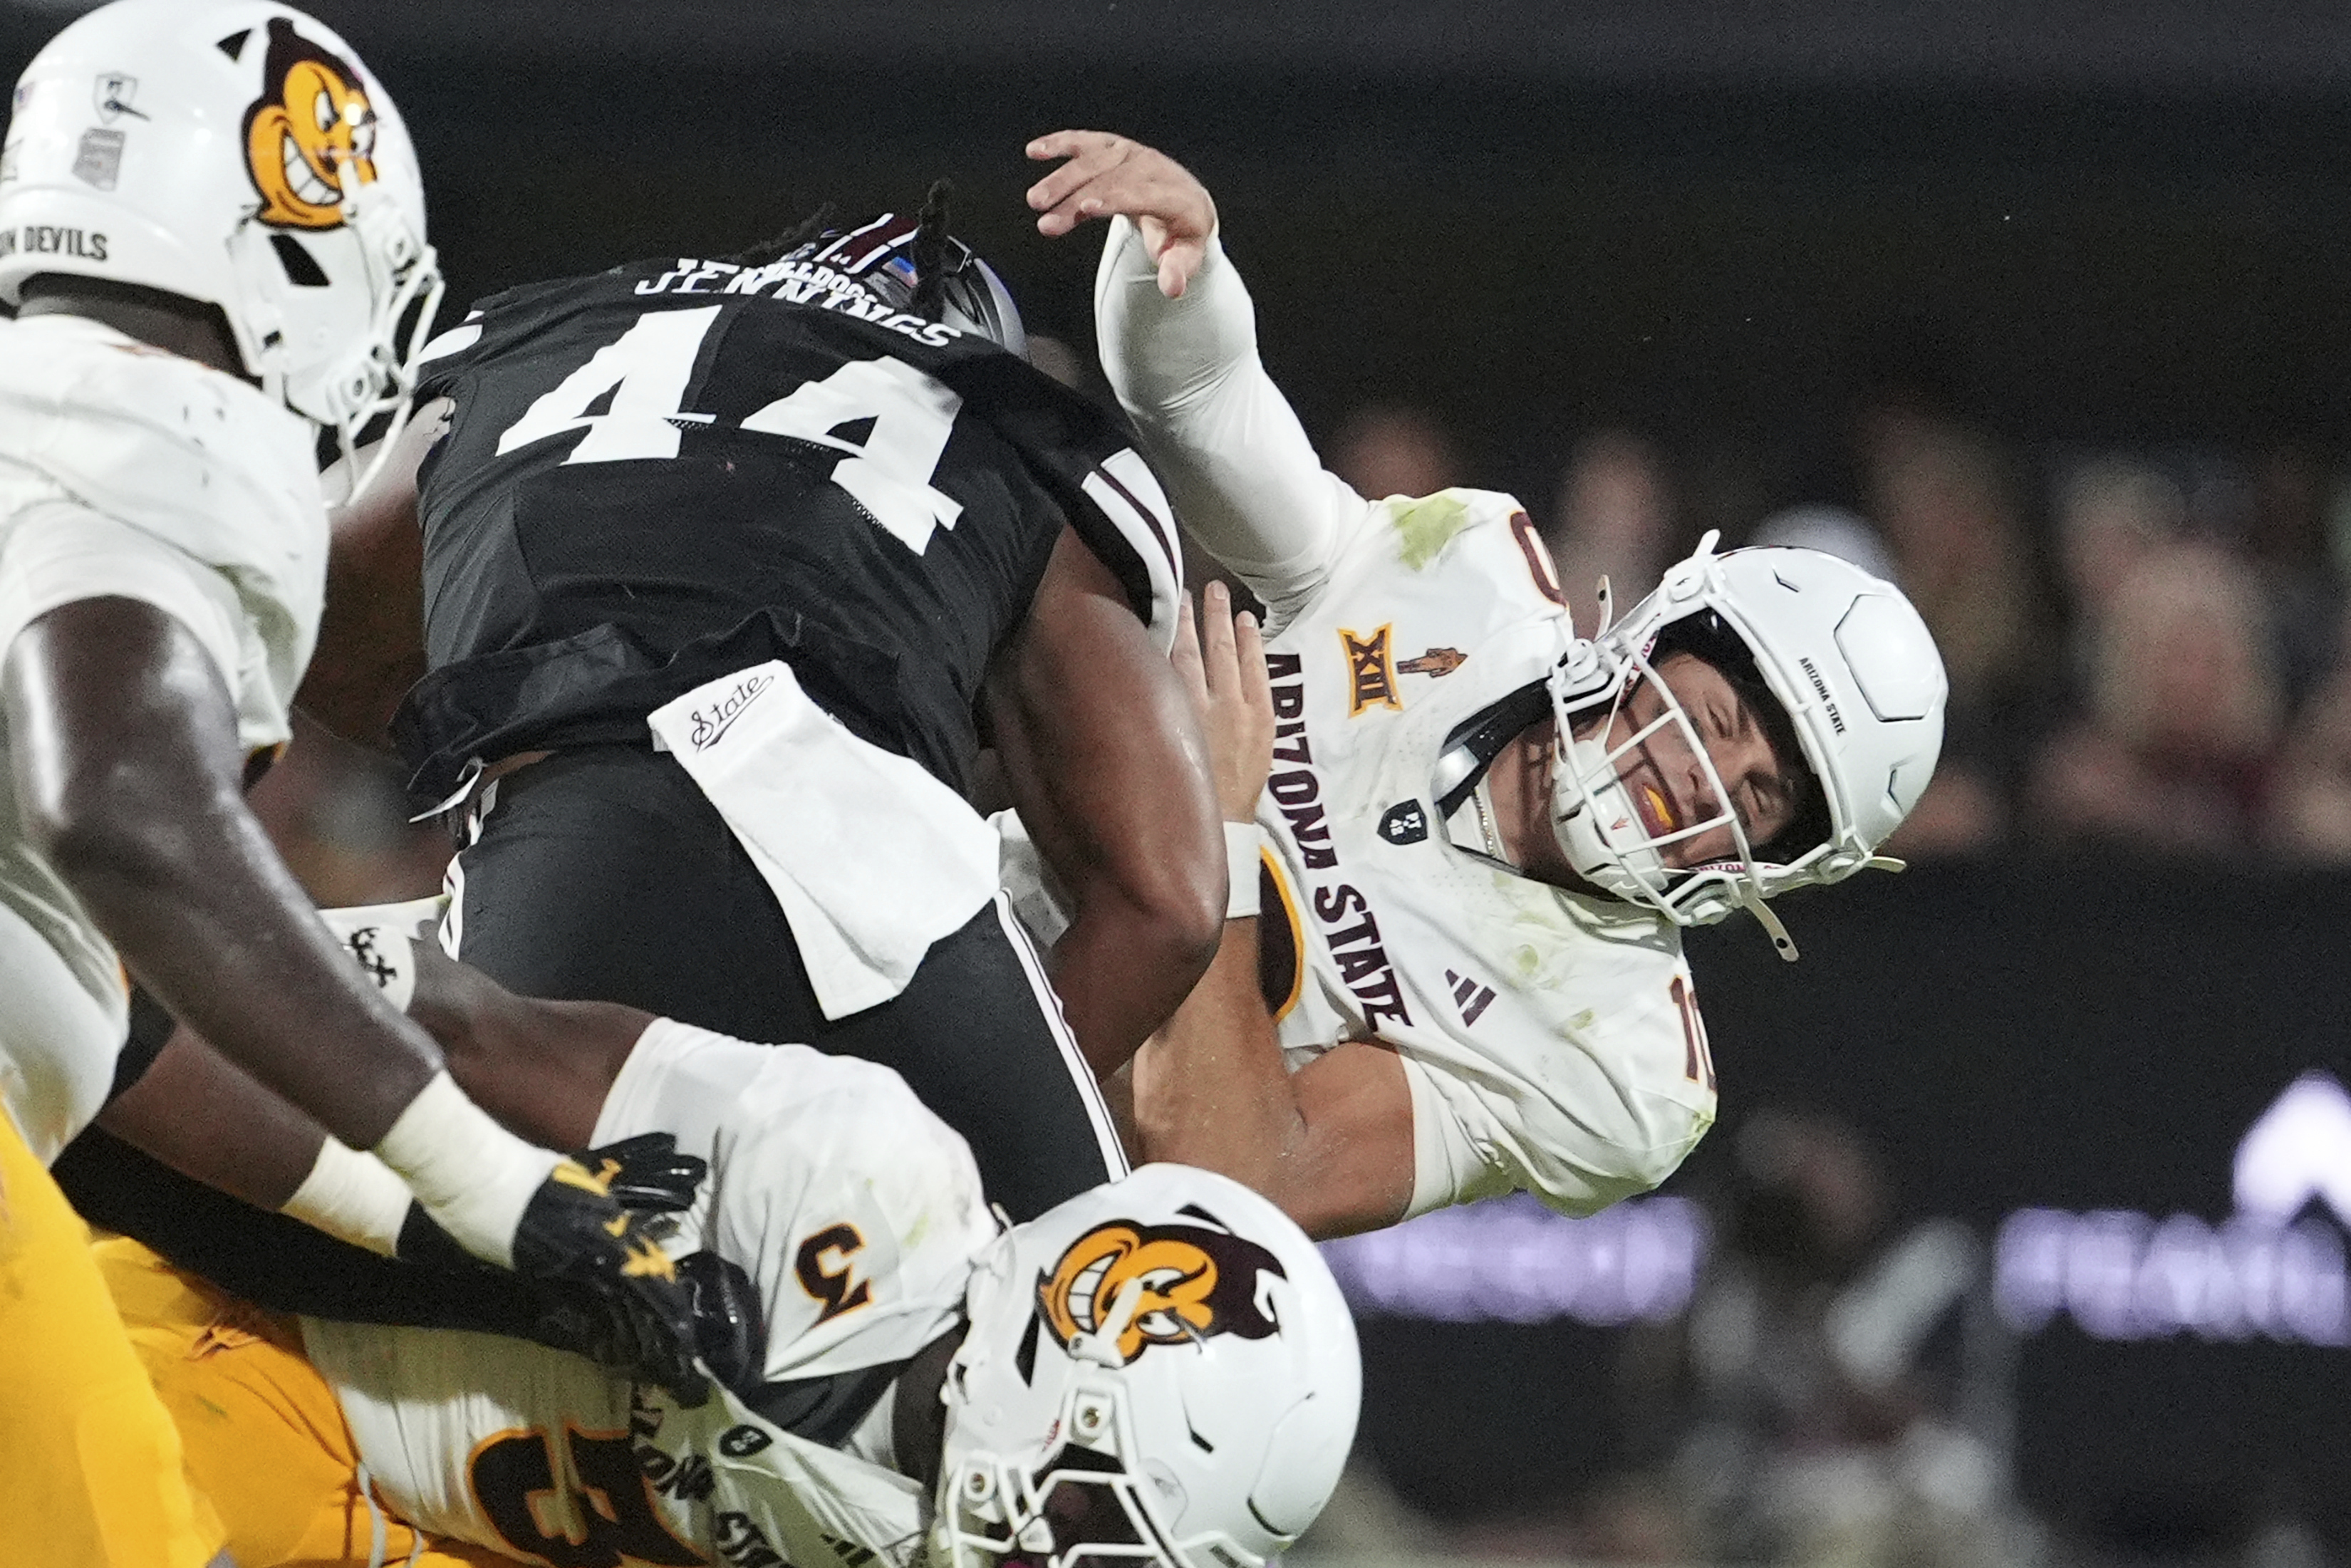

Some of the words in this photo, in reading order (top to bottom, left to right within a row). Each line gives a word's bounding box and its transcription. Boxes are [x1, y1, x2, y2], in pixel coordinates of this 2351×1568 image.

[25, 225, 108, 261] DEVILS
[634, 257, 962, 348] JENNINGS
[494, 304, 964, 556] 44
[690, 675, 775, 754] State
[1798, 657, 1830, 702] ARIZONA
[1825, 702, 1847, 737] STATE
[1314, 883, 1414, 1033] STATE
